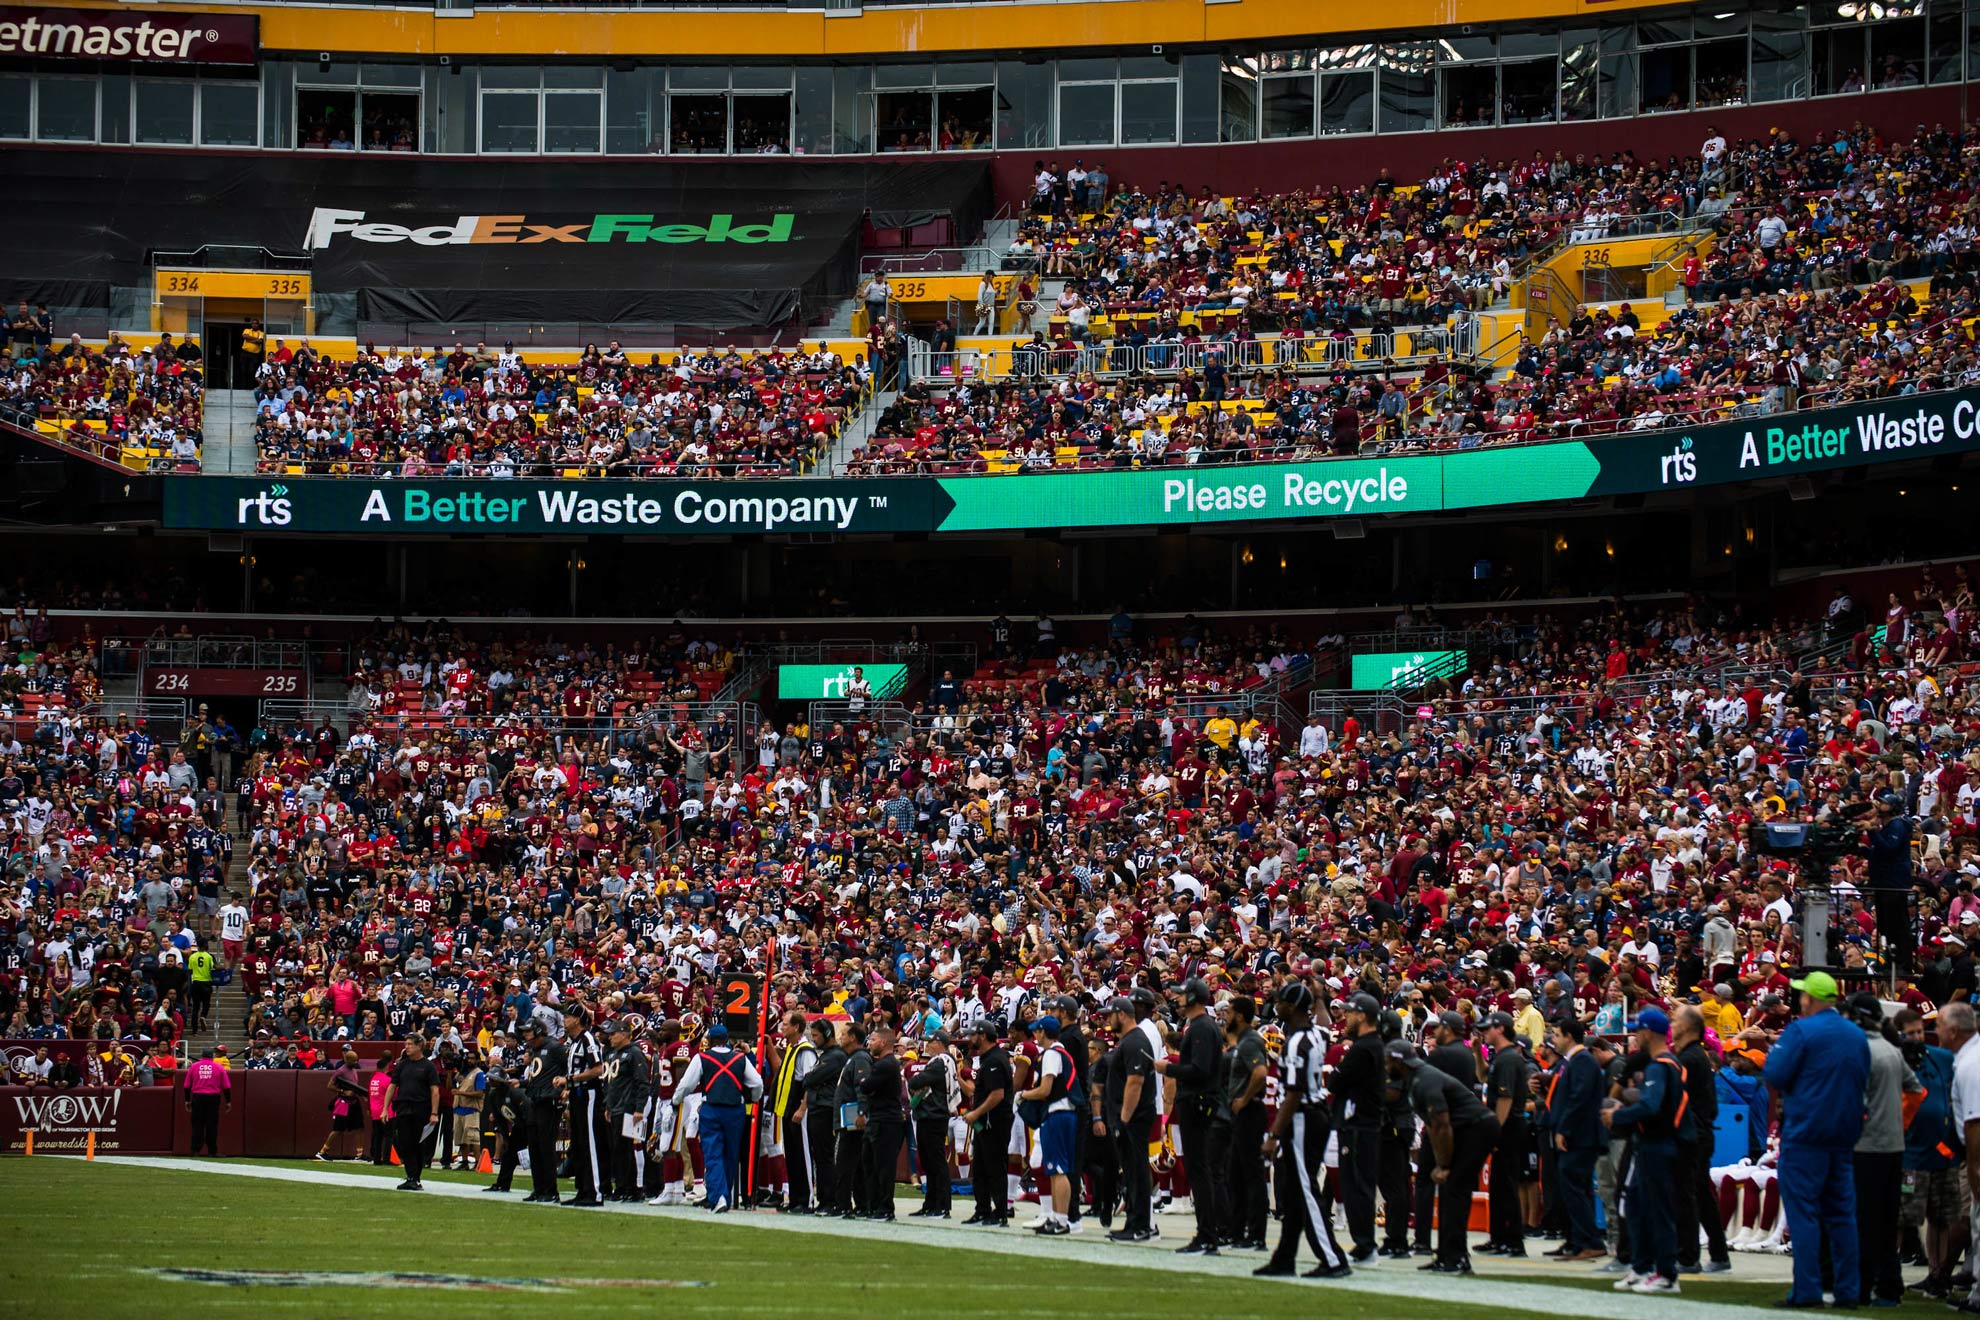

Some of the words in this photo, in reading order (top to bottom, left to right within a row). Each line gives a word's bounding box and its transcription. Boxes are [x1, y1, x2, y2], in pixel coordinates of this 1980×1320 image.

[0, 16, 202, 58] etmaster
[1353, 224, 1358, 232] 7
[1583, 248, 1610, 264] 336
[1386, 269, 1399, 280] 21
[1686, 266, 1692, 275] 7
[168, 277, 199, 292] 334
[269, 280, 300, 294] 335
[896, 283, 926, 298] 335
[601, 382, 614, 393] 54
[69, 399, 77, 410] 11
[1050, 431, 1060, 440] 91
[1090, 429, 1102, 439] 12
[1740, 432, 1760, 468] A
[1767, 424, 1850, 465] Better
[1857, 408, 1944, 452] Waste
[1152, 440, 1161, 449] 12
[1015, 447, 1024, 457] 91
[1661, 446, 1697, 484] rts
[1164, 478, 1266, 512] Please
[1284, 468, 1407, 512] Recycle
[238, 491, 292, 526] rts
[360, 490, 391, 522] A
[404, 490, 527, 522] Better
[538, 490, 661, 524] Waste
[674, 490, 858, 529] Company
[996, 628, 1008, 642] 12
[1915, 647, 1925, 662] 21
[408, 670, 414, 679] 9
[456, 673, 468, 683] 12
[27, 681, 36, 690] 11
[156, 674, 189, 690] 234
[263, 676, 297, 692] 235
[1148, 685, 1160, 699] 14
[574, 696, 580, 706] 4
[136, 744, 147, 755] 21
[812, 746, 823, 757] 12
[1500, 742, 1511, 756] 12
[417, 761, 429, 772] 89
[889, 759, 900, 771] 12
[937, 763, 947, 774] 11
[1578, 759, 1594, 775] 37
[339, 774, 350, 784] 12
[1181, 768, 1197, 781] 47
[1512, 773, 1521, 787] 12
[241, 784, 250, 795] 12
[1347, 778, 1359, 790] 81
[643, 794, 654, 808] 12
[1231, 794, 1238, 806] 7
[32, 808, 44, 820] 32
[476, 803, 491, 814] 26
[532, 825, 542, 836] 21
[973, 828, 984, 841] 12
[1046, 822, 1063, 836] 54
[192, 838, 208, 850] 54
[224, 839, 232, 851] 11
[937, 850, 949, 861] 12
[1138, 854, 1153, 869] 87
[1458, 868, 1473, 884] 36
[388, 894, 396, 902] 91
[414, 899, 431, 912] 28
[37, 914, 48, 926] 12
[110, 908, 123, 922] 12
[227, 913, 240, 928] 10
[531, 924, 541, 936] 12
[643, 922, 654, 936] 12
[457, 933, 466, 945] 11
[7, 954, 20, 969] 12
[198, 956, 204, 967] 6
[364, 950, 379, 961] 05
[81, 958, 90, 971] 12
[255, 961, 267, 975] 91
[33, 986, 39, 998] 8
[726, 981, 750, 1014] 2
[673, 992, 683, 1007] 91
[1920, 1000, 1936, 1013] 81
[390, 1010, 406, 1026] 87
[458, 1014, 465, 1023] 91
[959, 1011, 968, 1029] 12
[776, 1037, 787, 1048] 74
[658, 1058, 672, 1086] 6
[13, 1088, 121, 1126] WOW!
